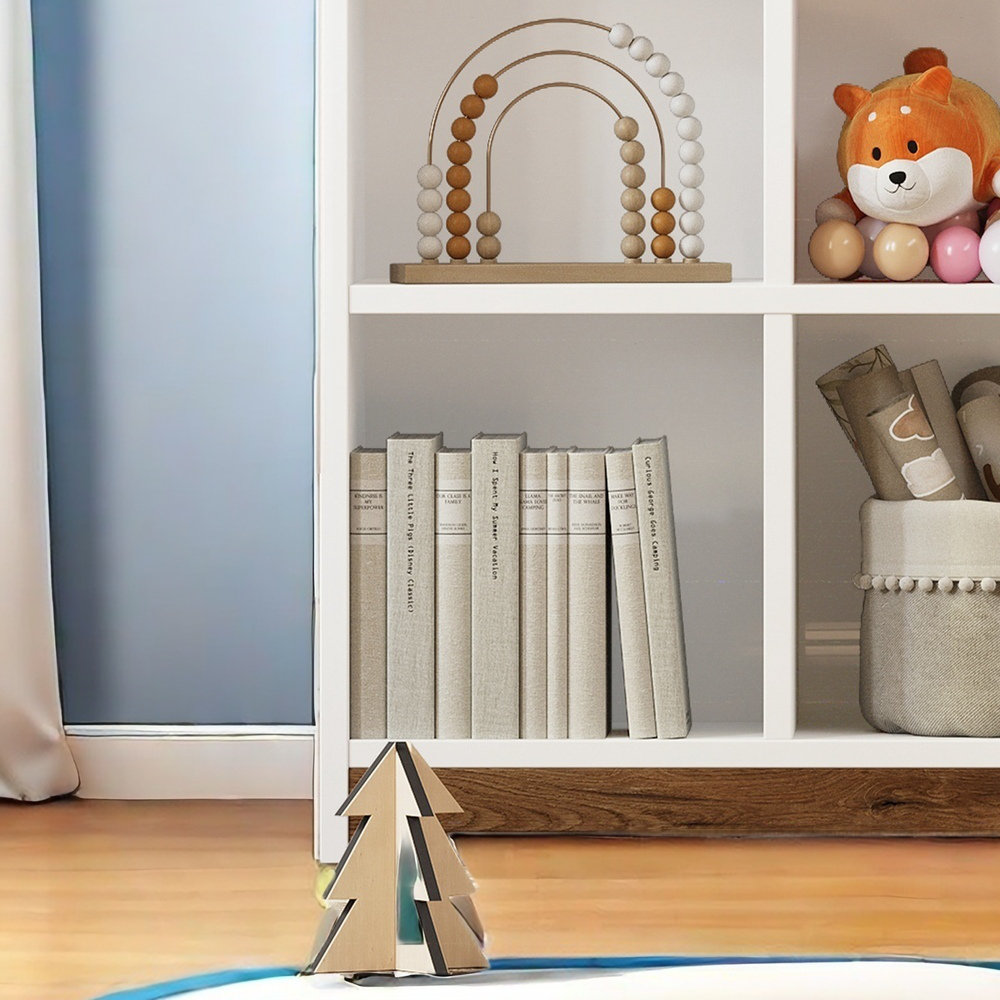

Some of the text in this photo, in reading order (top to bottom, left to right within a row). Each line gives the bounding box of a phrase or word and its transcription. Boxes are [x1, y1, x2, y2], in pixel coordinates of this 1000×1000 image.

[491, 451, 499, 465] How
[491, 477, 499, 499] Spent
[490, 502, 499, 512] My
[644, 456, 661, 572] Curious George Goes Camping
[406, 451, 415, 613] The Three Little Pigs (Disney Classic)
[491, 515, 499, 541] Summer
[491, 544, 499, 580] Vacation
